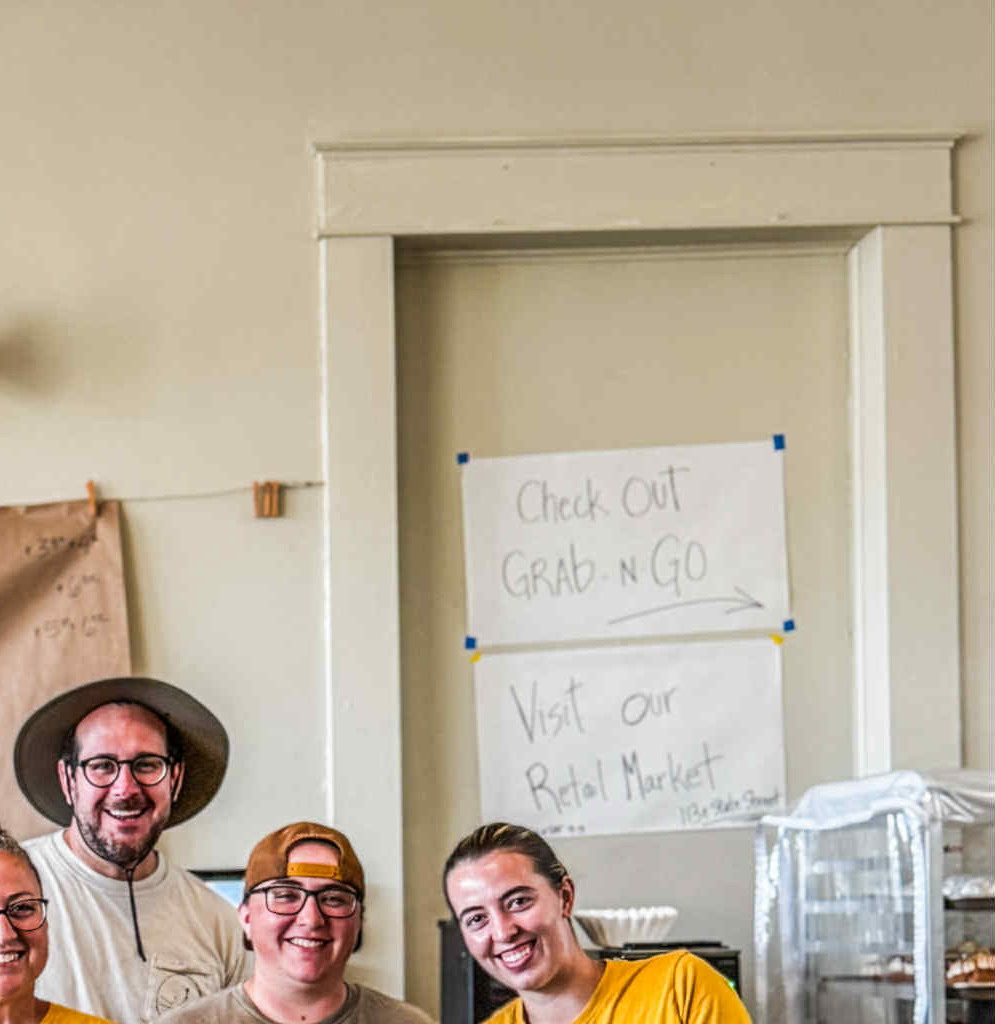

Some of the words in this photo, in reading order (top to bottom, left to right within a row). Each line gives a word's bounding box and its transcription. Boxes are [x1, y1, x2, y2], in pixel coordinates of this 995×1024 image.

[516, 478, 610, 524] Check
[509, 676, 586, 744] Visit
[621, 740, 725, 801] Market
